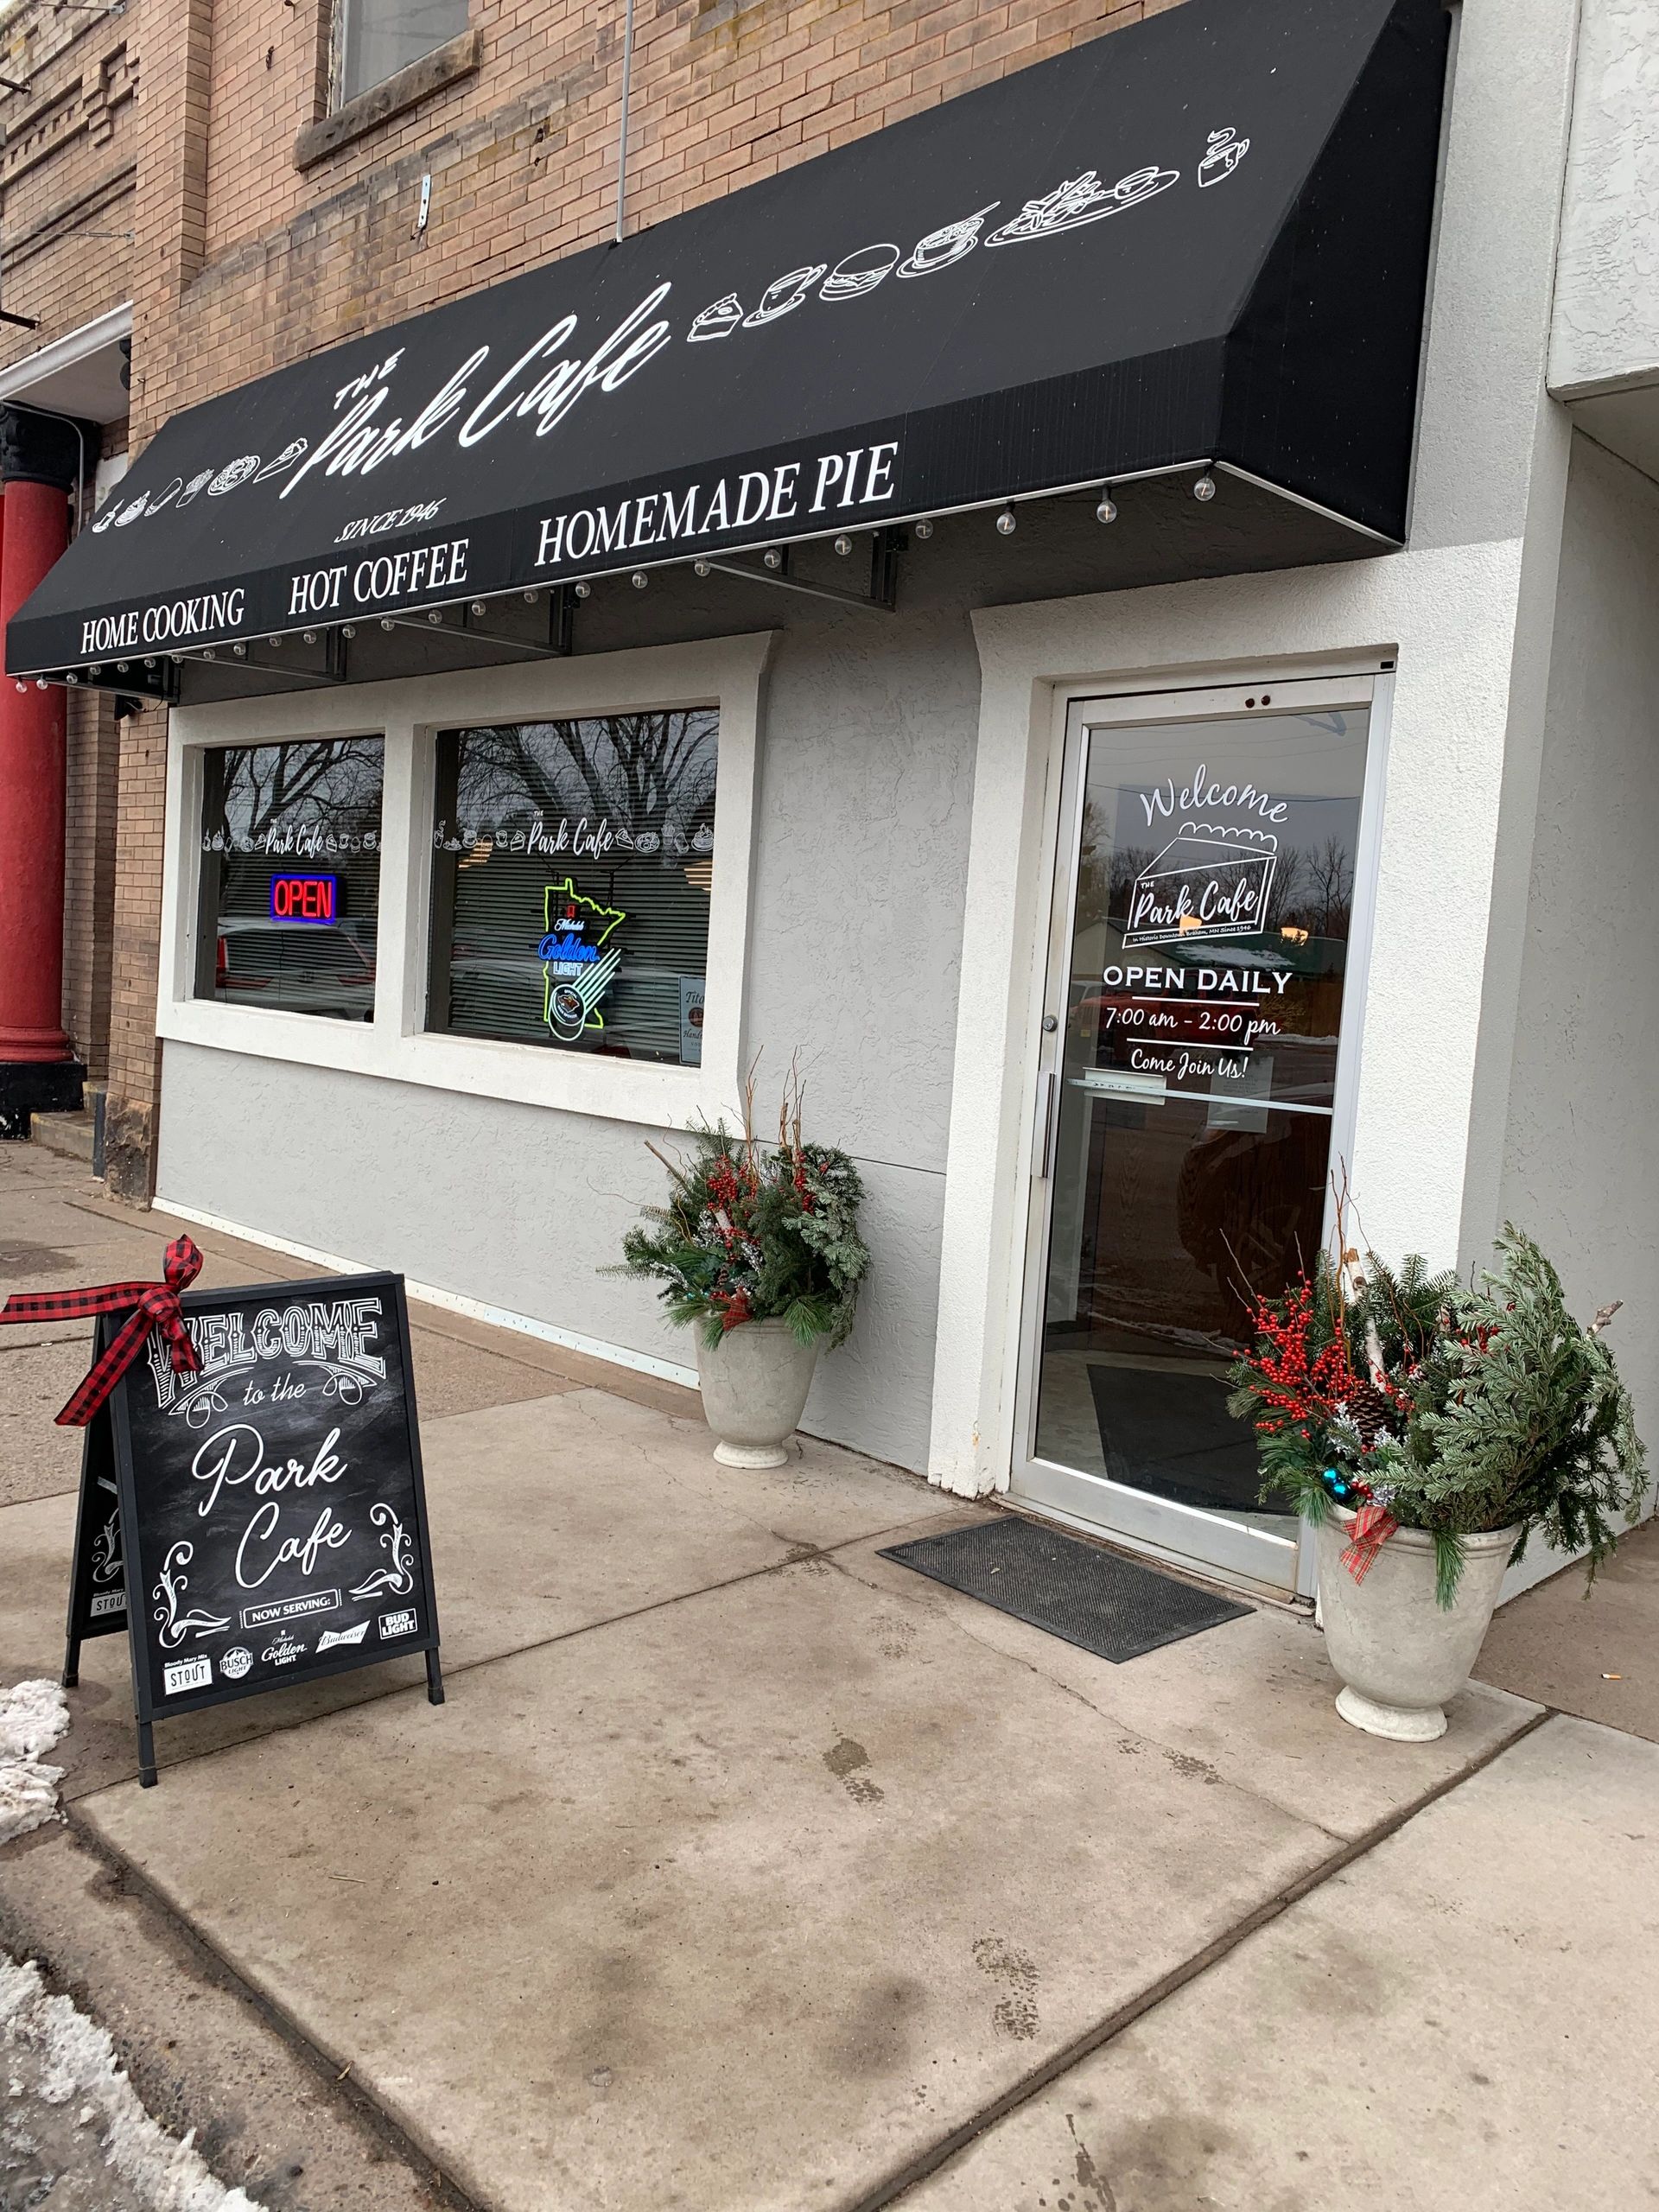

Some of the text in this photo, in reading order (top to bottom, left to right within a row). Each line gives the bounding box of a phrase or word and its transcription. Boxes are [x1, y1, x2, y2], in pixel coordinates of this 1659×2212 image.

[279, 282, 672, 499] Park Cafe
[334, 347, 405, 410] THE
[334, 498, 447, 543] SINCE 1946
[534, 442, 899, 567] HOMEMADE PIE
[288, 538, 469, 615] HOT COFFEE
[79, 588, 245, 655] HOME COOKING
[1140, 764, 1288, 827] Welcome
[265, 823, 324, 859] Park Cafe
[527, 817, 614, 861] Park Cafe
[274, 880, 332, 918] OPEN
[1141, 880, 1154, 889] THE
[1134, 877, 1259, 929] Park Cafe
[537, 933, 601, 962] Golden
[553, 962, 583, 976] LIGHT
[1103, 965, 1293, 994] OPEN DAILY
[1105, 1007, 1145, 1029] 7:00
[1148, 1013, 1178, 1028] am
[1198, 1011, 1243, 1032] 2:00
[1243, 1019, 1281, 1046] pm
[1130, 1048, 1249, 1080] Come Join Us!
[243, 1372, 307, 1406] to the
[191, 1423, 348, 1516] Park
[235, 1501, 353, 1589] Cafe
[96, 1593, 127, 1611] STOU
[251, 1596, 331, 1622] NOW SERVING:
[382, 1619, 416, 1637] LIGHT
[385, 1612, 410, 1626] BUD
[261, 1642, 308, 1662] Golden
[318, 1630, 366, 1647] Budweiser
[164, 1659, 182, 1668] Bloody
[183, 1656, 198, 1664] Mary
[170, 1664, 206, 1687] STOUT
[220, 1655, 253, 1671] BUSCH
[228, 1666, 247, 1675] LIGHT
[275, 1654, 296, 1667] LIGHT
